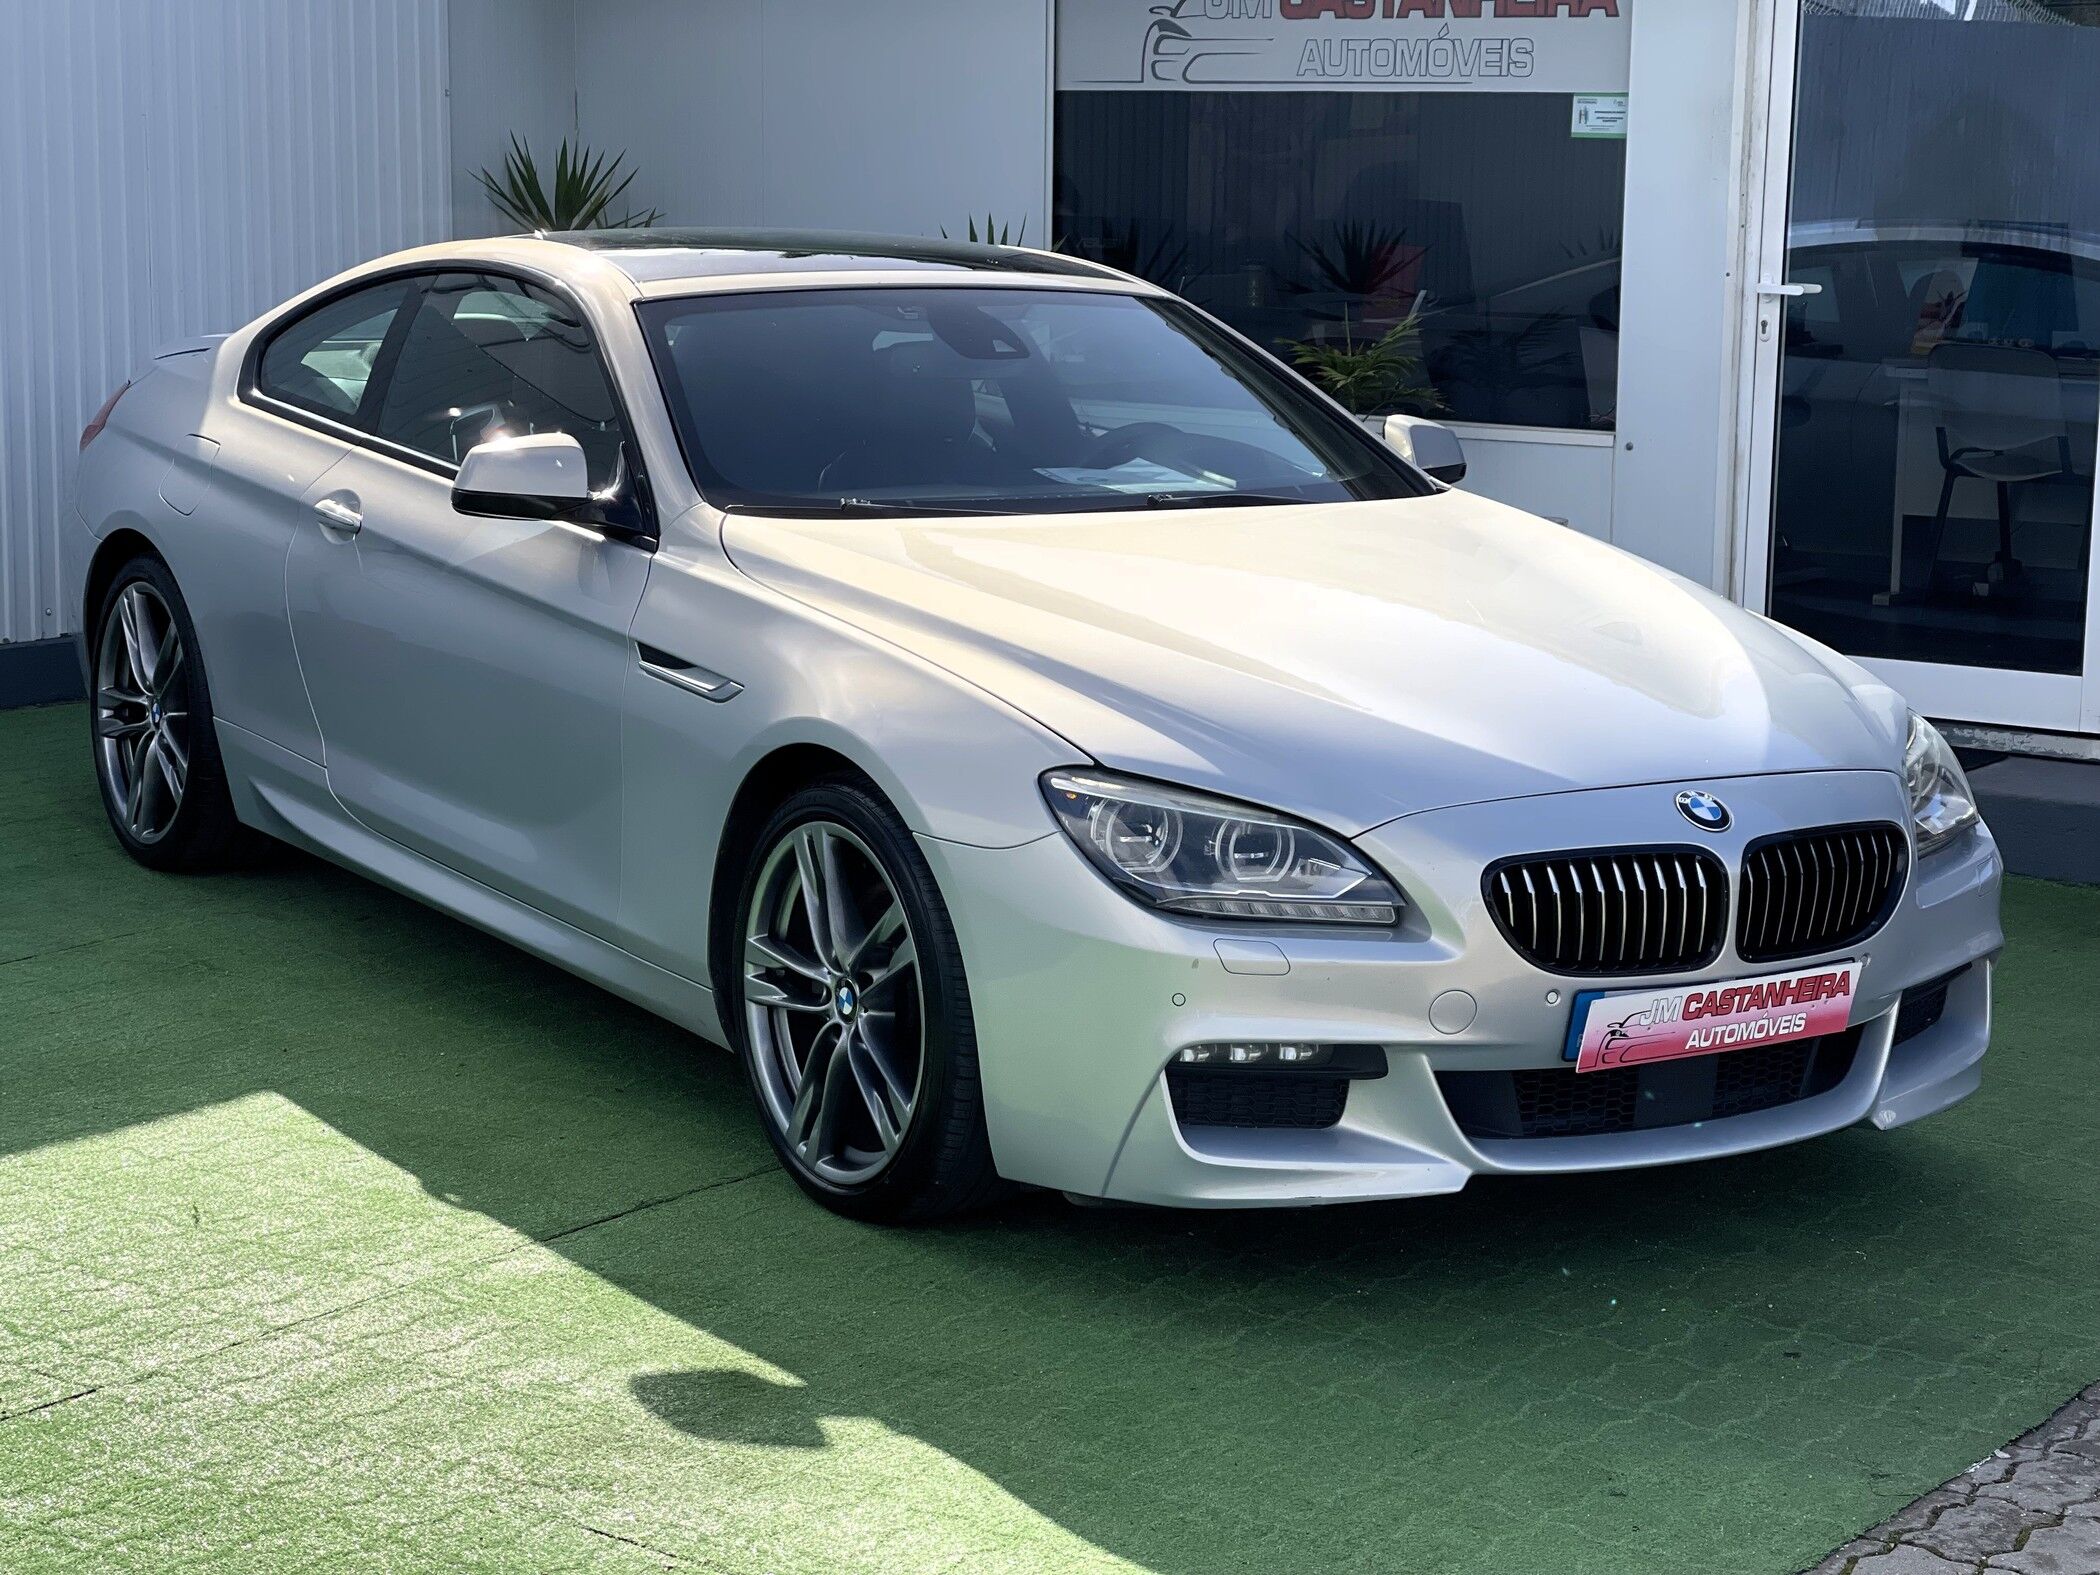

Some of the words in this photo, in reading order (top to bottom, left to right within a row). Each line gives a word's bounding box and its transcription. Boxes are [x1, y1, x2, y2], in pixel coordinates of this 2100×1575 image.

[1297, 22, 1534, 77] AUTOMÓVEIS
[1638, 996, 1683, 1027] JM
[1682, 971, 1850, 1021] CASTANHEIRA
[1685, 1011, 1807, 1050] AUTOMÓVEIS
